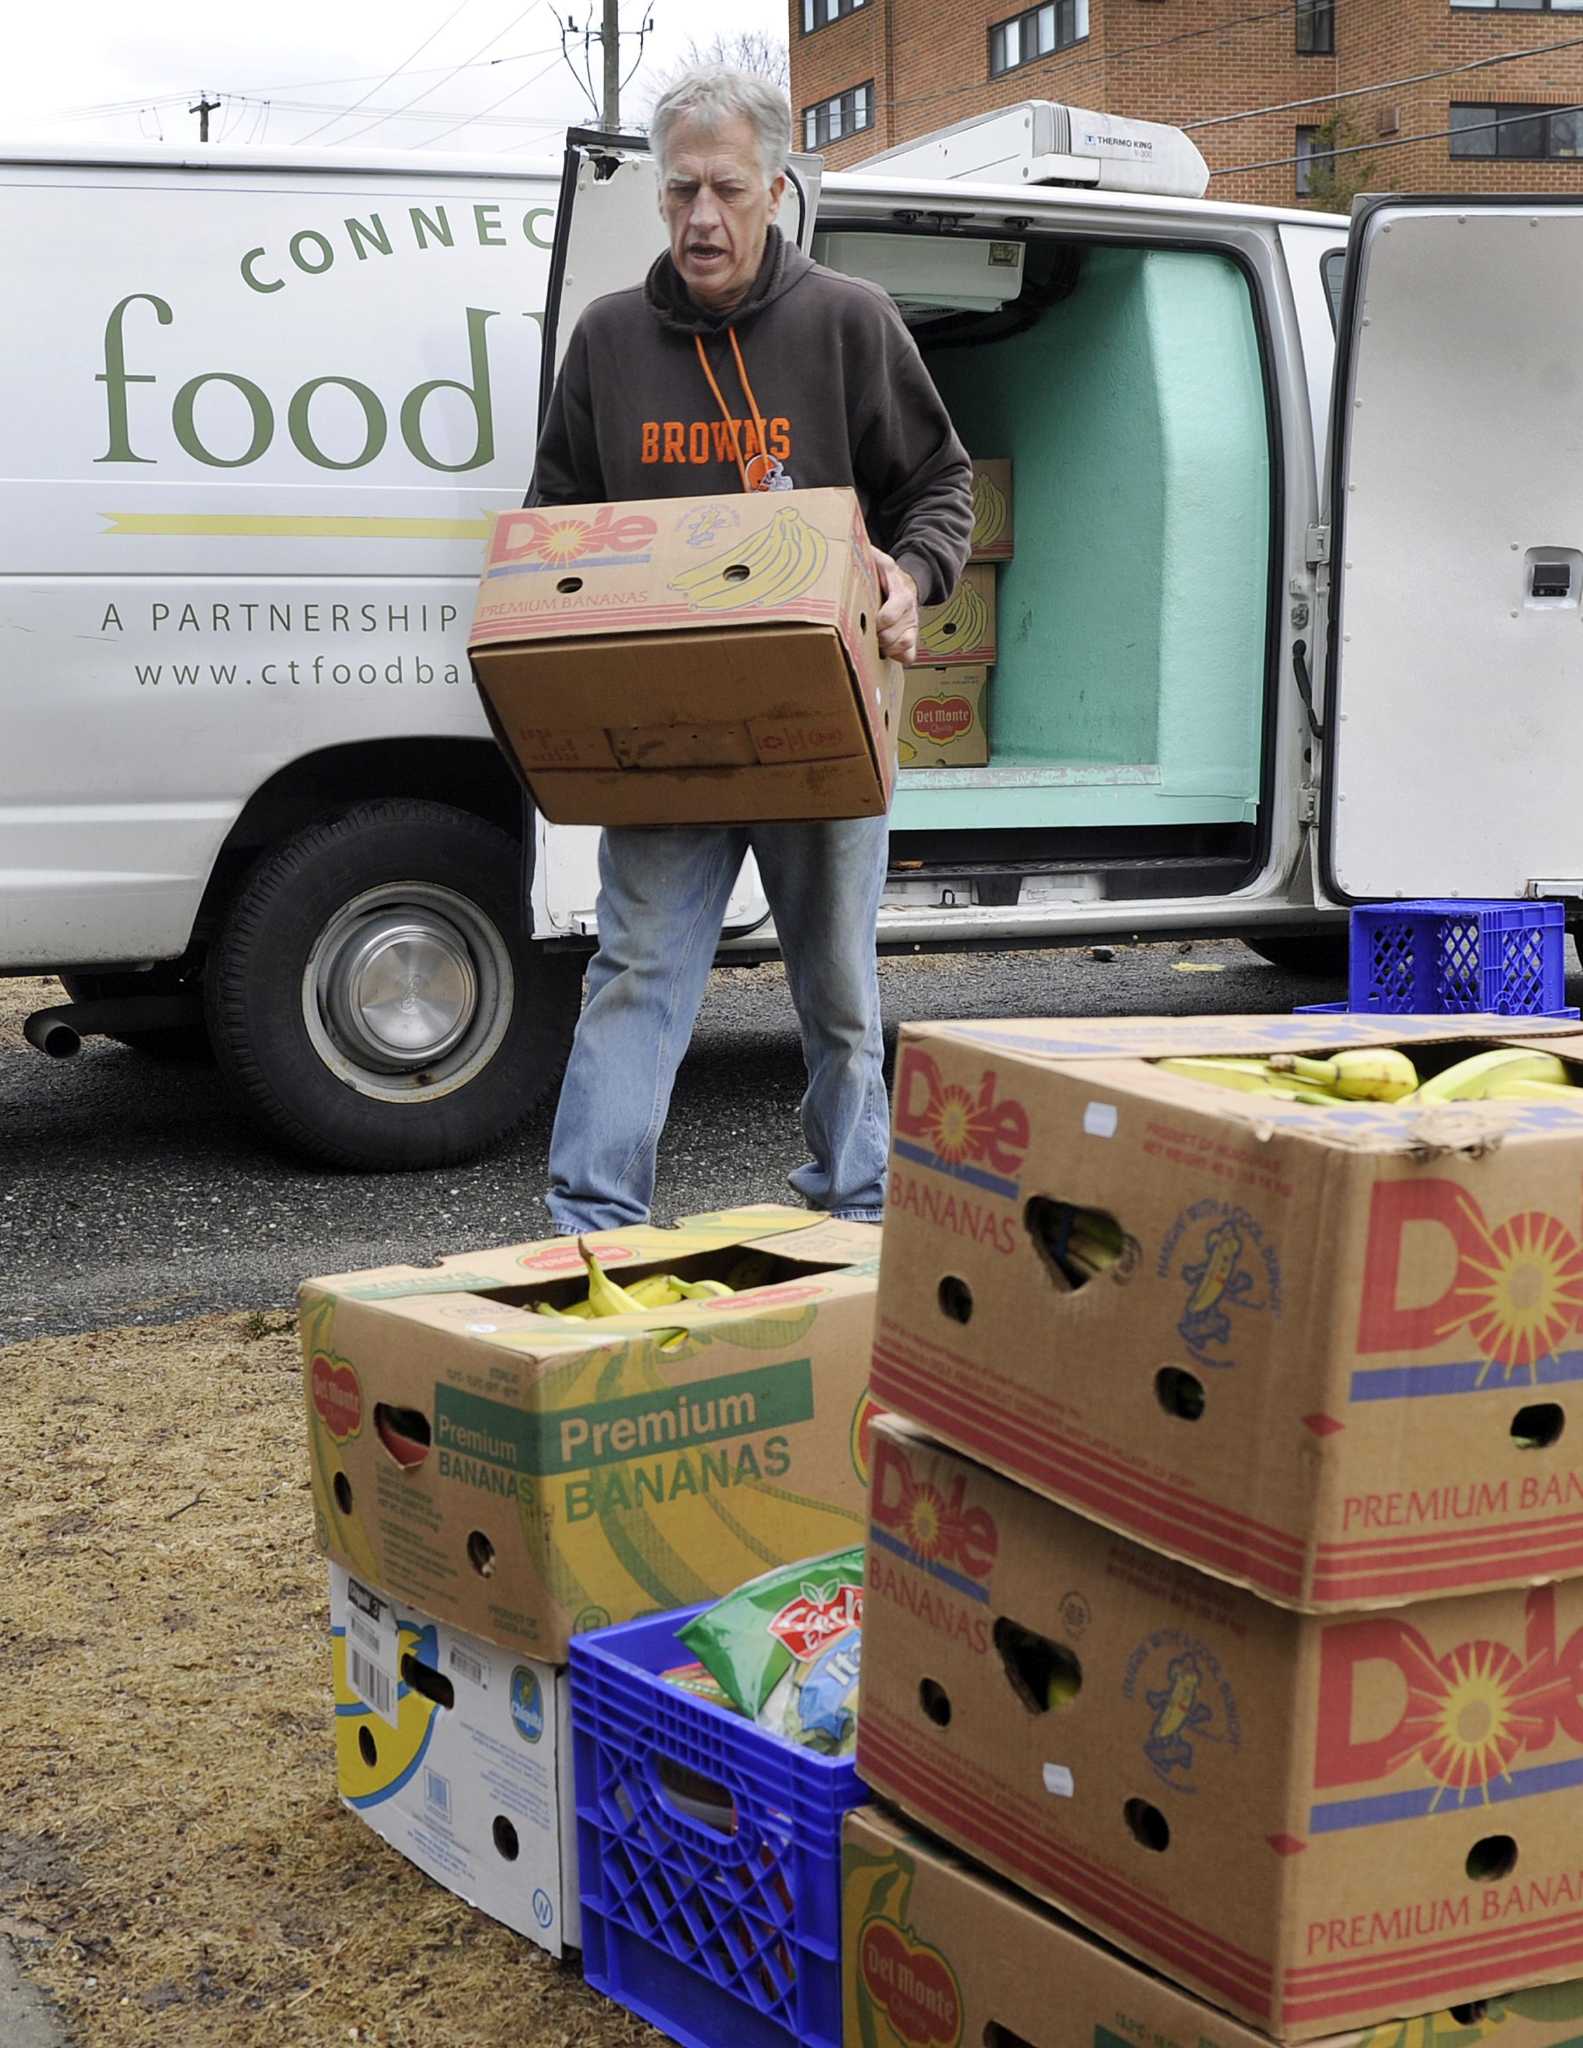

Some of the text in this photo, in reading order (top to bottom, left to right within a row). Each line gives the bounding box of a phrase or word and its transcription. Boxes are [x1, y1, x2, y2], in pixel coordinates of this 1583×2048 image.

[1097, 136, 1152, 149] THERMO KING
[93, 293, 545, 473] food
[641, 417, 791, 464] BROWNS
[490, 506, 657, 564] Dole
[101, 603, 457, 632] A PARTNERSHIP
[480, 591, 648, 618] PREMIUM BANANAS
[916, 709, 969, 722] Del Monte
[894, 1046, 1031, 1175] Dole
[889, 1172, 1017, 1256] BANANAS
[439, 1414, 517, 1463] Premium
[560, 1391, 755, 1462] Premium
[439, 1452, 535, 1503] BANANAS
[565, 1435, 791, 1523] BANANAS
[871, 1438, 998, 1578] Dole
[1342, 1480, 1509, 1532] PREMIUM
[869, 1556, 988, 1654] BANANAS
[1306, 1870, 1583, 1955] PREMIUM BANA
[868, 1943, 894, 1984] Del
[897, 1963, 955, 2025] Monte
